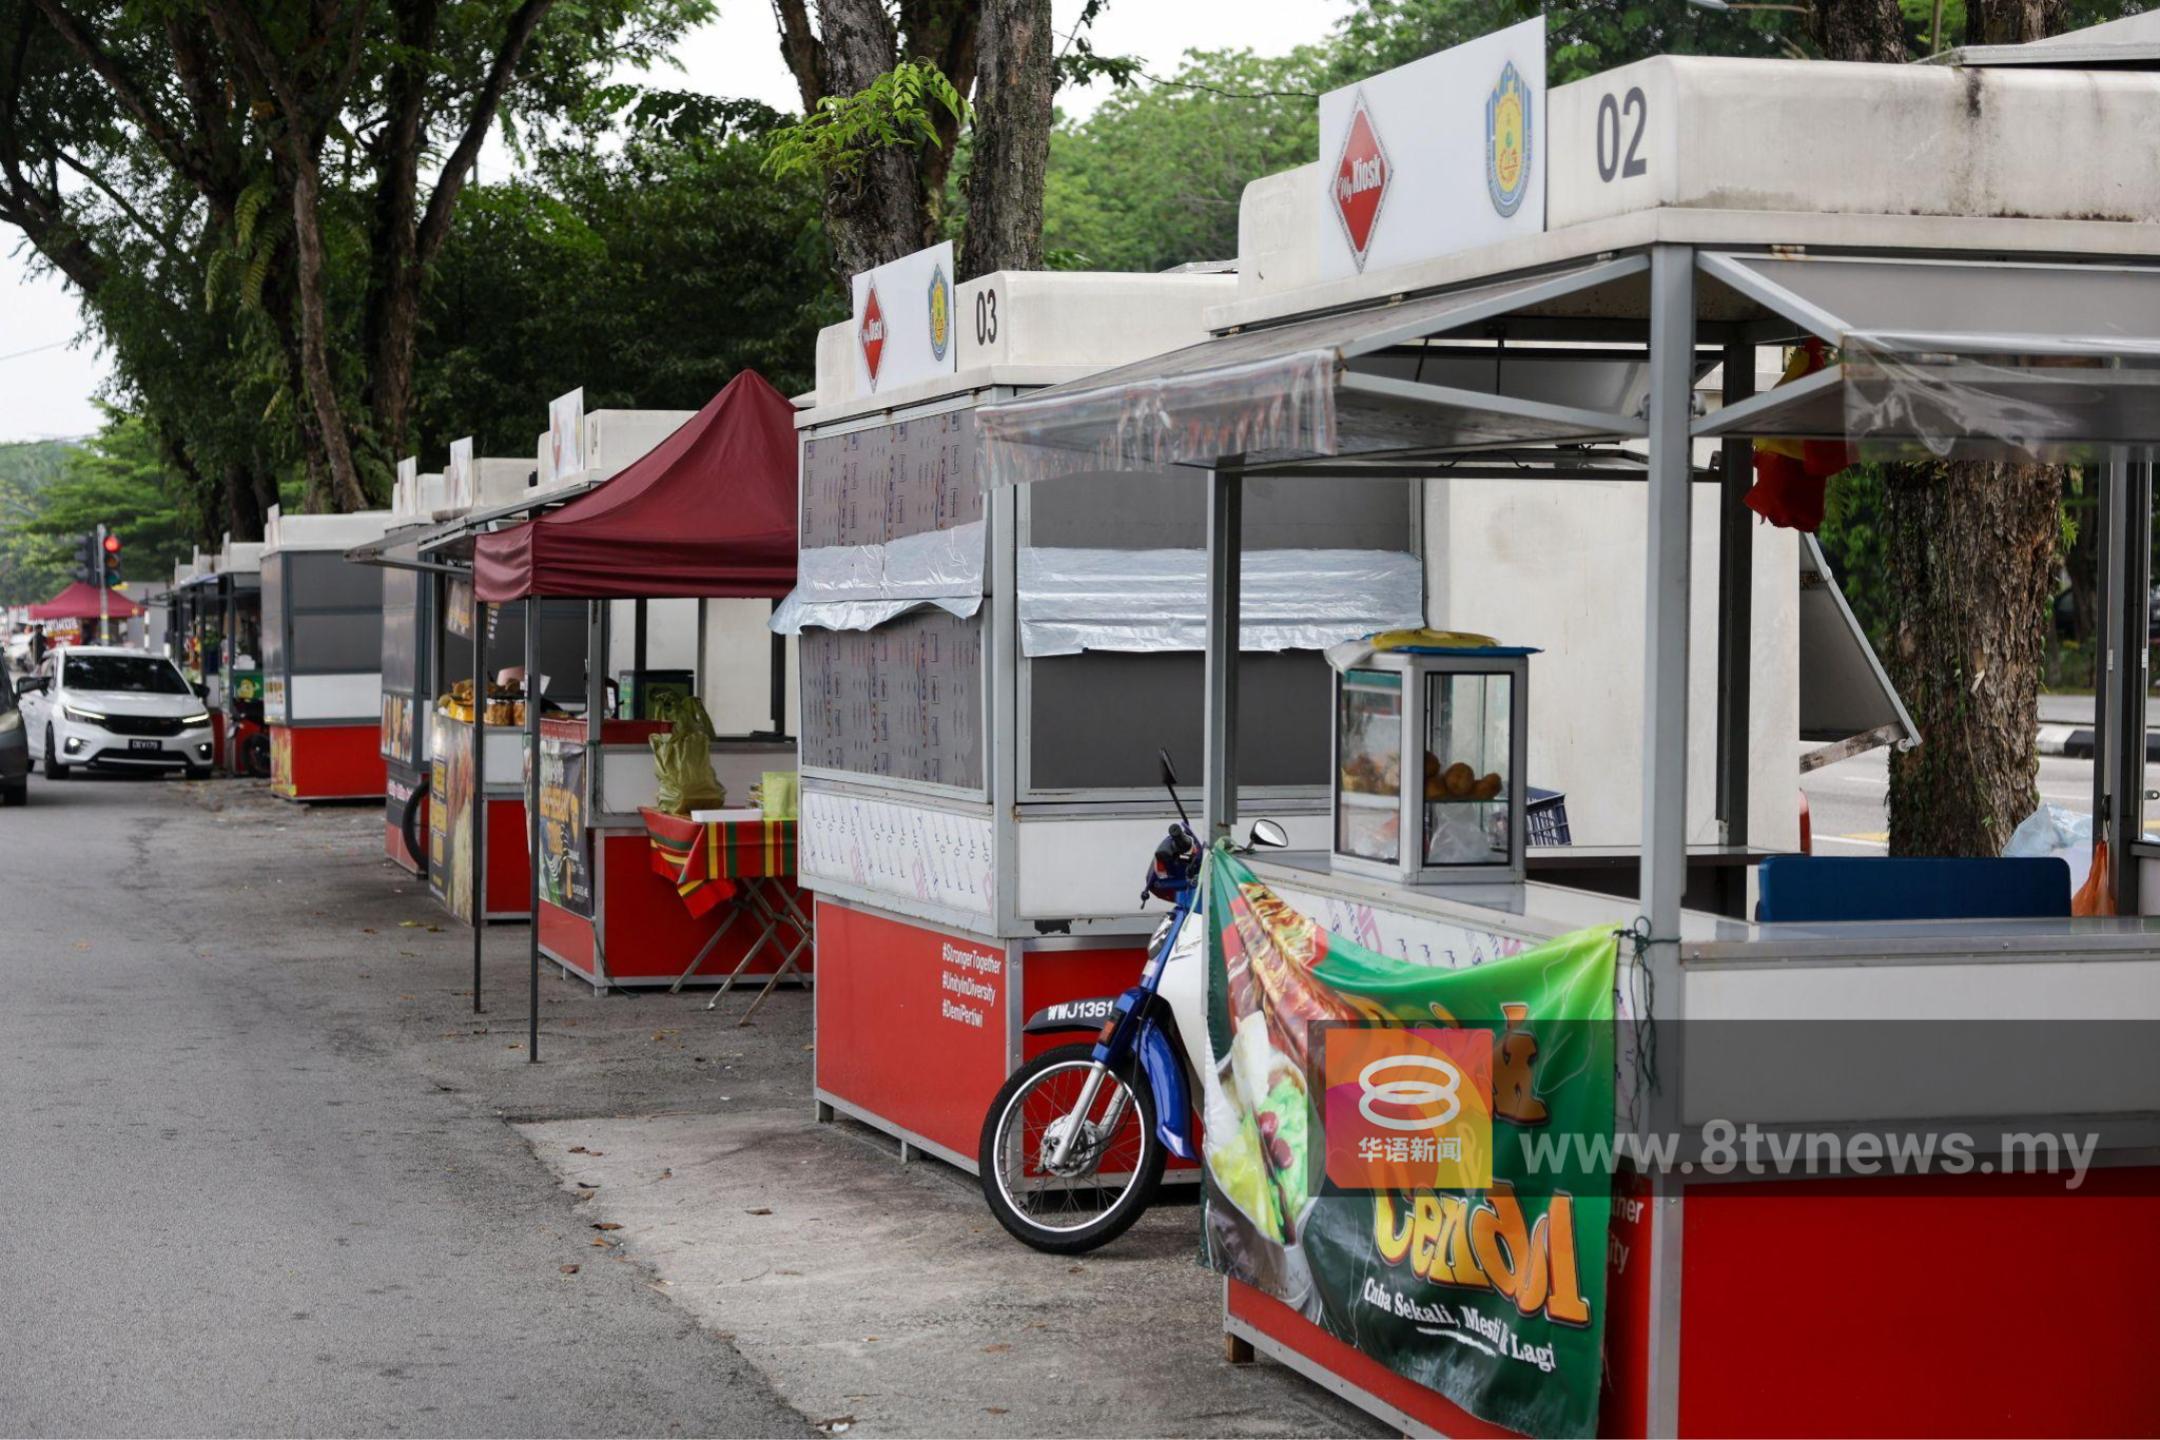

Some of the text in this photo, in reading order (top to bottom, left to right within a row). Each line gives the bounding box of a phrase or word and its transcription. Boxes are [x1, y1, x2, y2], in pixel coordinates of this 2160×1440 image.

[1597, 86, 1647, 183] 02
[976, 288, 997, 346] 03
[942, 942, 1002, 975] #StrongerTogether
[942, 970, 996, 1008] #UnityInDiversity
[942, 998, 983, 1028] #DemiPertiwi
[1364, 1276, 1392, 1313] Cuba
[1394, 1291, 1462, 1329] Sekali,
[1511, 1331, 1557, 1373] Lagi
